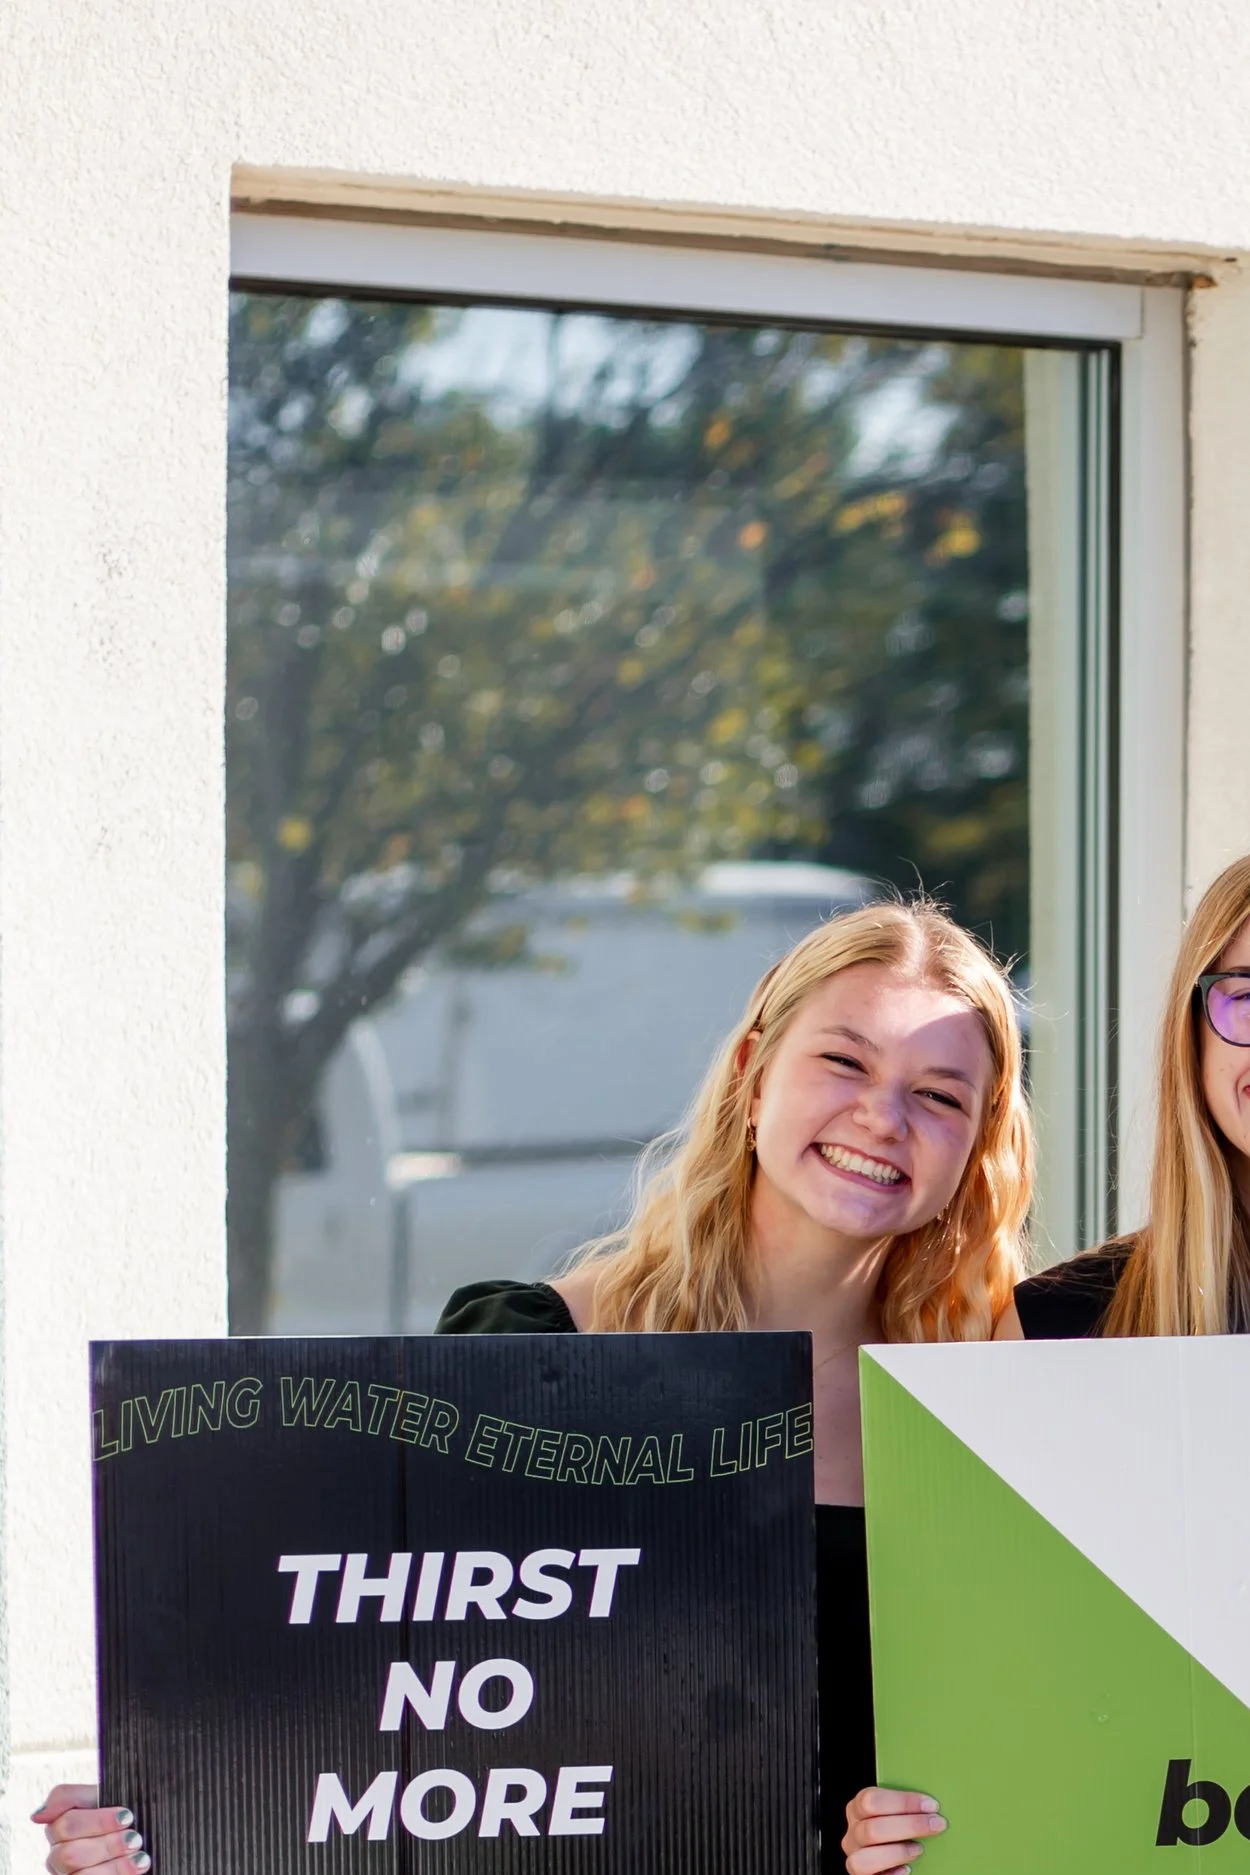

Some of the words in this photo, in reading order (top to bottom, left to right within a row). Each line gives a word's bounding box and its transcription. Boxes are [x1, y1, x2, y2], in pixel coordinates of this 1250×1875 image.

[92, 1376, 263, 1462] LIVING
[279, 1376, 459, 1454] WATER
[464, 1413, 695, 1485] ETERNAL
[710, 1402, 813, 1478] LIFE
[277, 1547, 642, 1624] THIRST
[379, 1657, 534, 1731] NO
[306, 1765, 614, 1843] MORE
